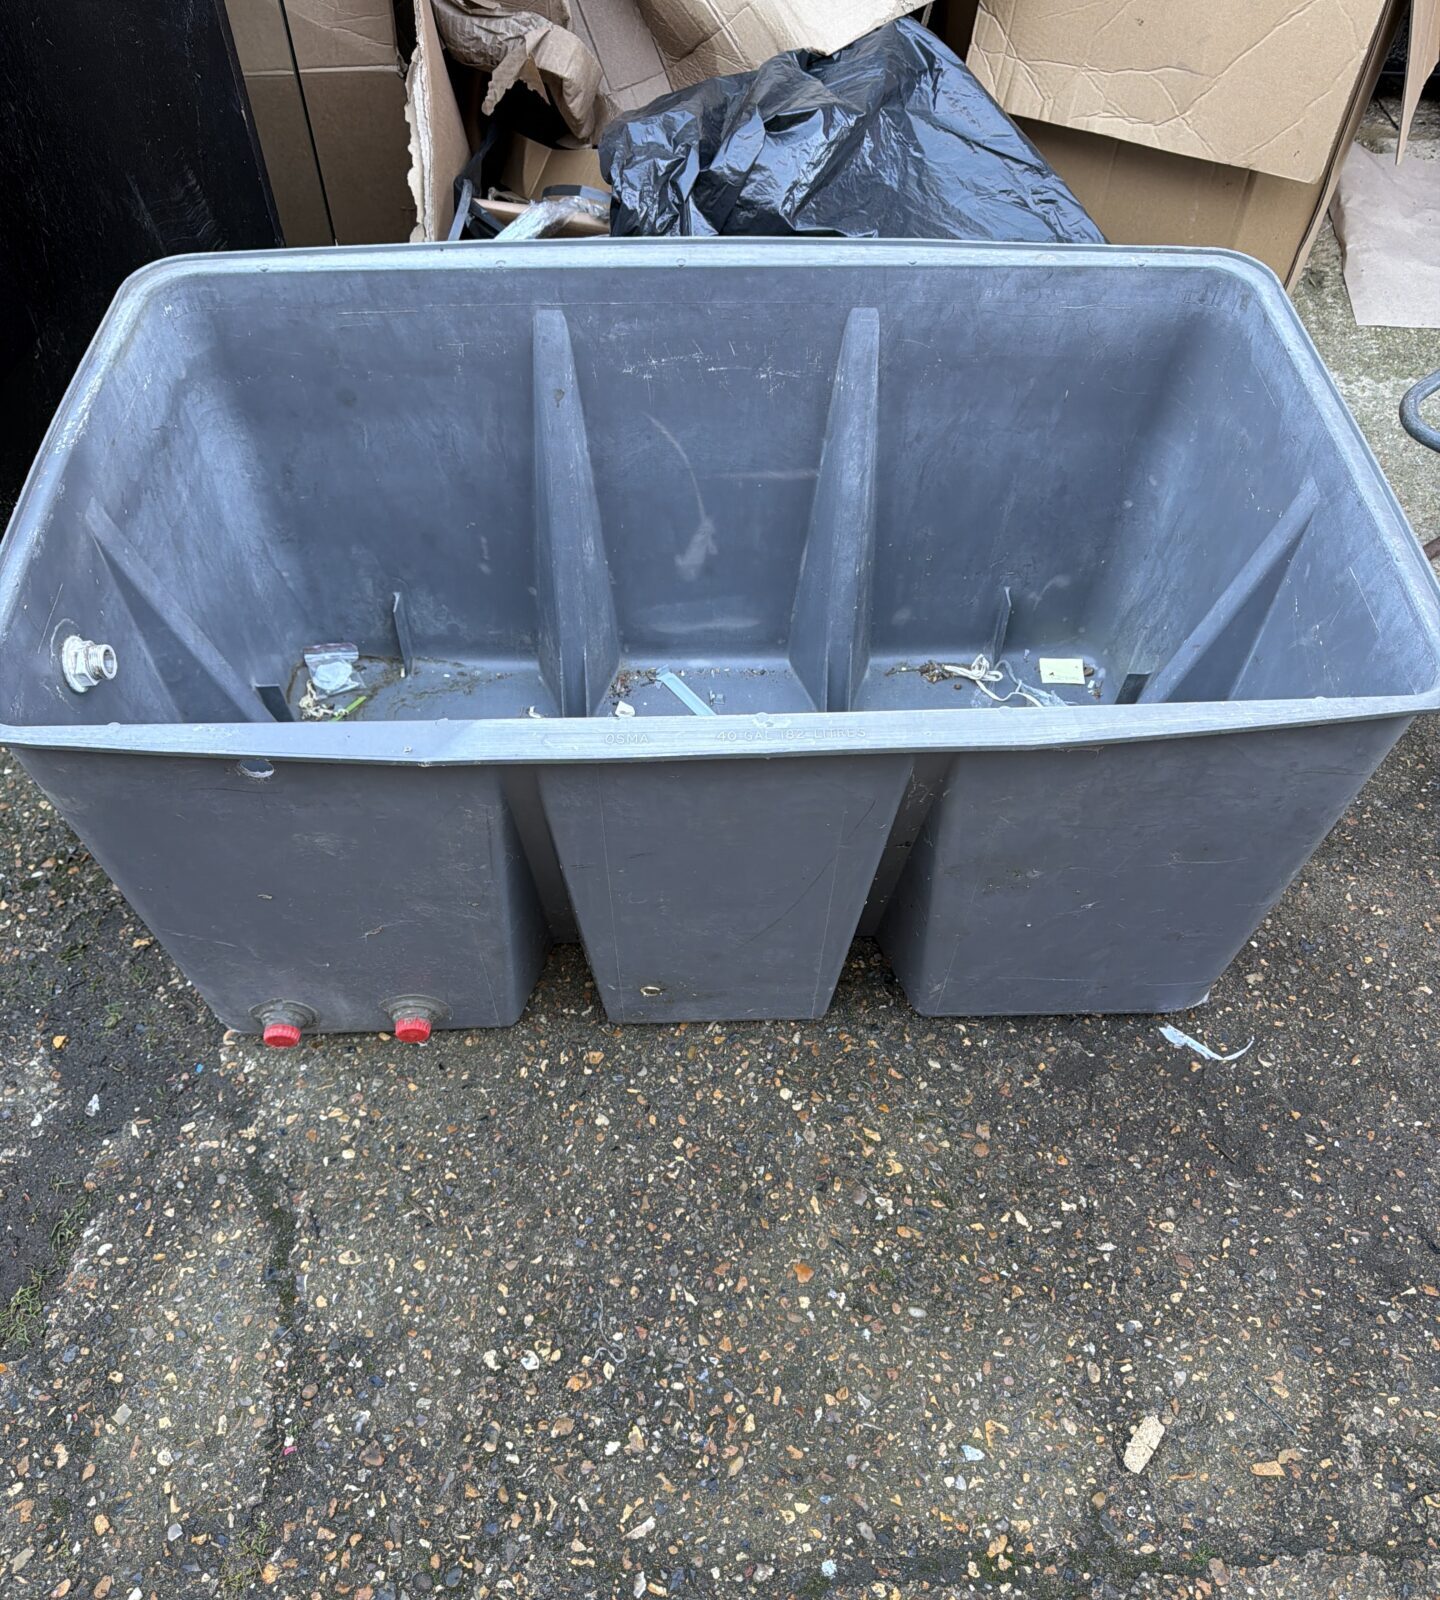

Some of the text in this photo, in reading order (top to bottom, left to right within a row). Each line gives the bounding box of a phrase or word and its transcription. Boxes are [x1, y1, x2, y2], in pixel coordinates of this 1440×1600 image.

[604, 727, 867, 745] OSMA 40 GAL 182 LITRES
